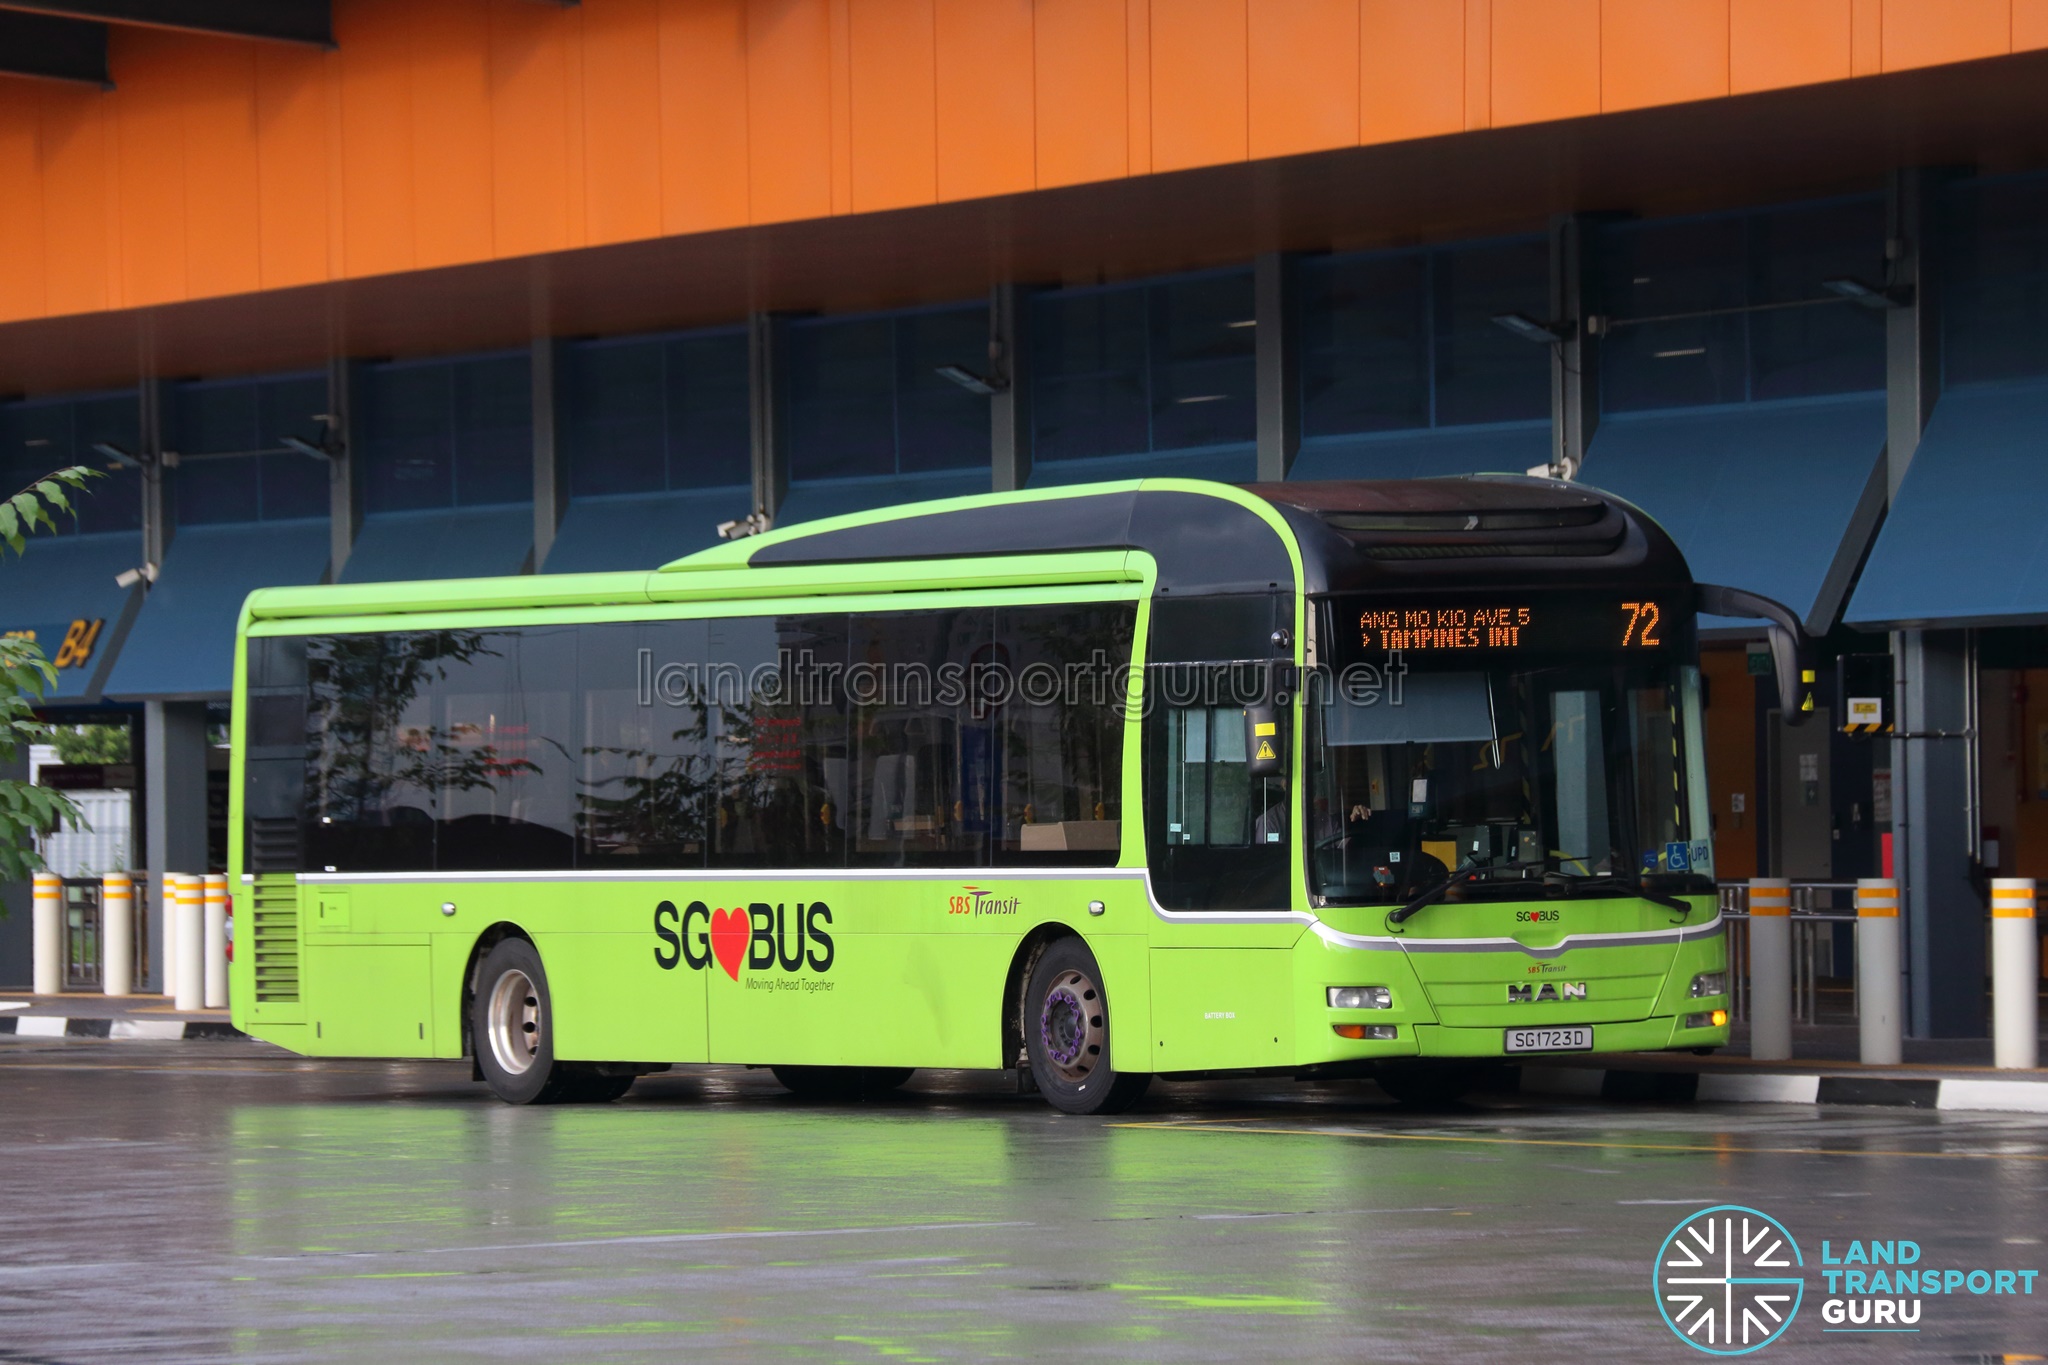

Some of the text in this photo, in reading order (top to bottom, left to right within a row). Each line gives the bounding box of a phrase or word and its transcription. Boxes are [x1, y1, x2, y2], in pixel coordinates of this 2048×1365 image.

[1360, 607, 1530, 628] ANG MO KIO AVE 5
[1621, 602, 1660, 647] 72
[54, 618, 103, 668] B4
[1380, 625, 1520, 649] TAMPINES INT
[949, 891, 1021, 918] SBS Transit
[1528, 963, 1567, 974] SBS Transit
[745, 977, 834, 994] Moving Ahead Together
[1508, 982, 1587, 1003] MAN
[1515, 1031, 1583, 1047] SG1723D
